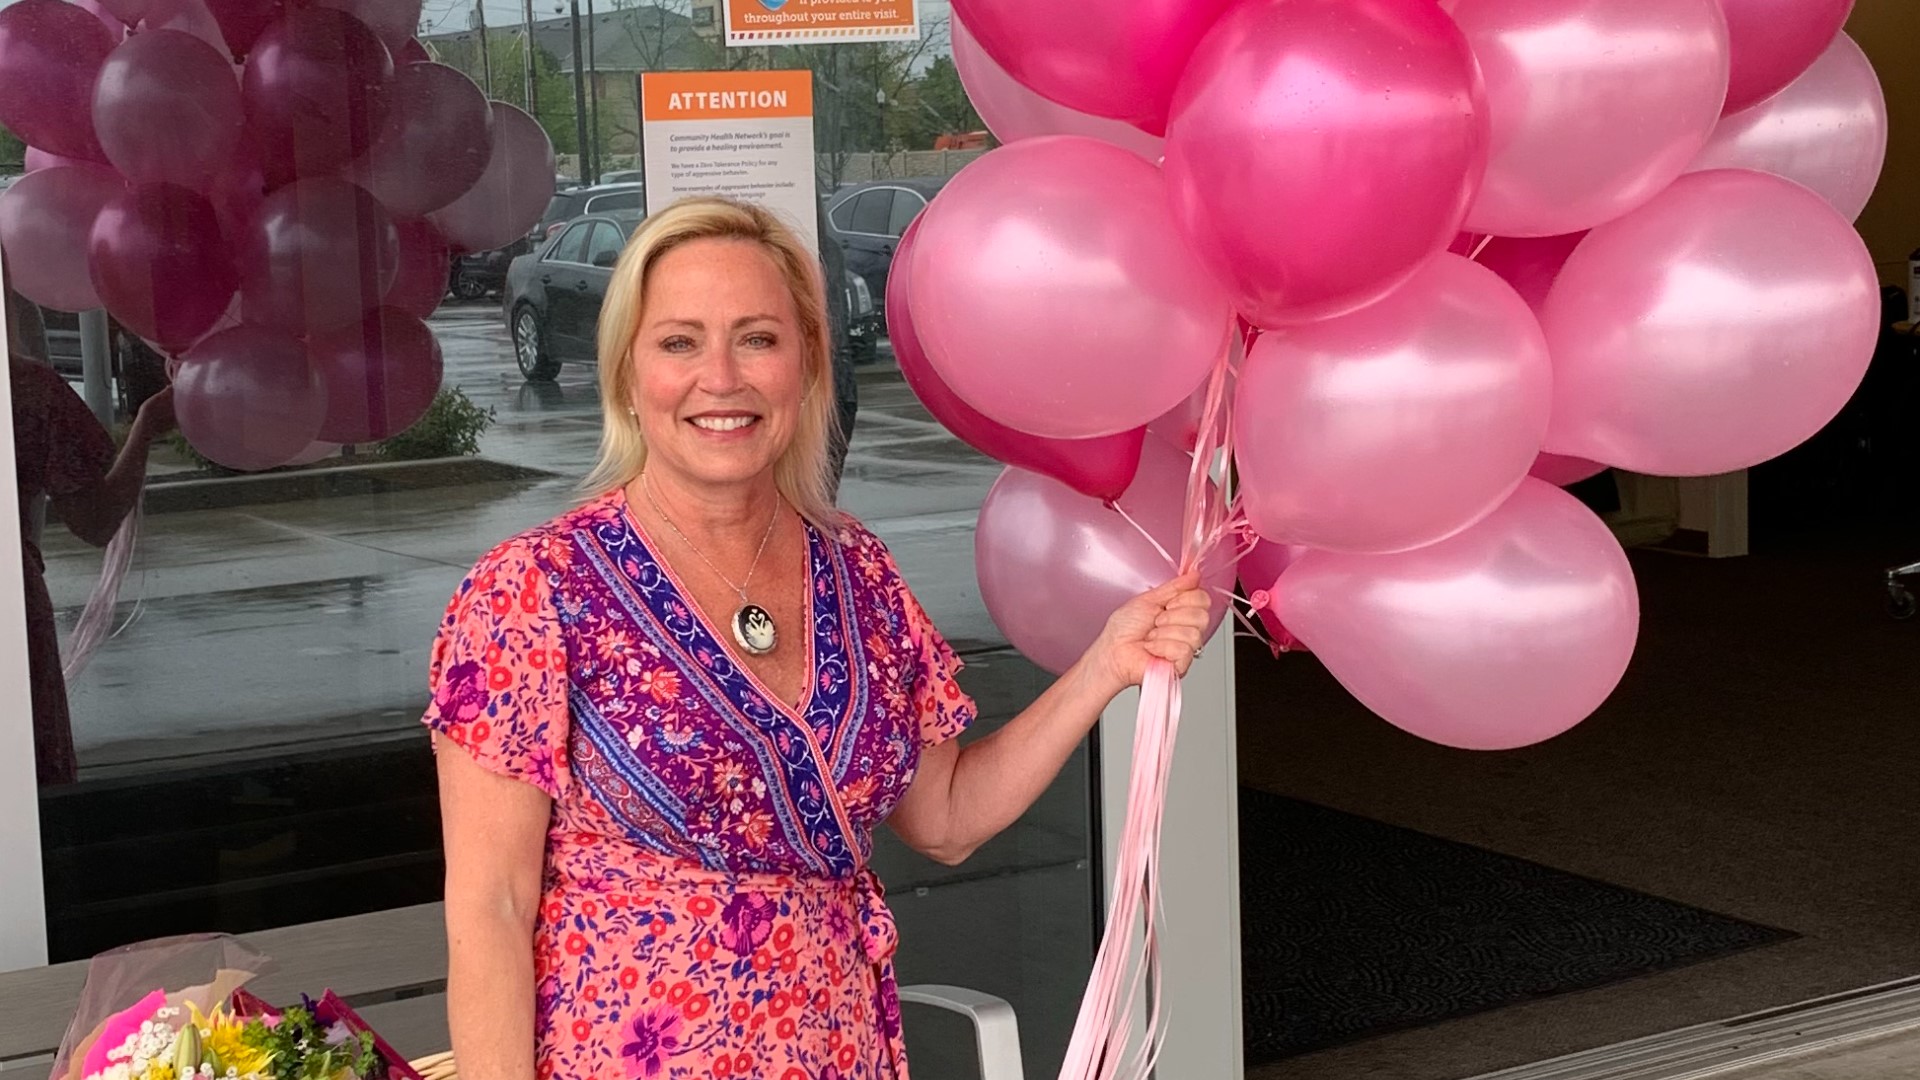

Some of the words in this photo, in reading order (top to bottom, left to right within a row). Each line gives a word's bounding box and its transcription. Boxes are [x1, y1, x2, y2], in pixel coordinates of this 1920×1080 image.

[744, 12, 808, 24] throughout
[811, 12, 836, 24] your
[839, 9, 871, 20] entire
[668, 90, 787, 110] ATTENTION
[670, 134, 709, 142] Community
[735, 131, 767, 140] Network's
[769, 131, 784, 140] goal
[678, 144, 704, 154] provide
[712, 143, 737, 152] healing
